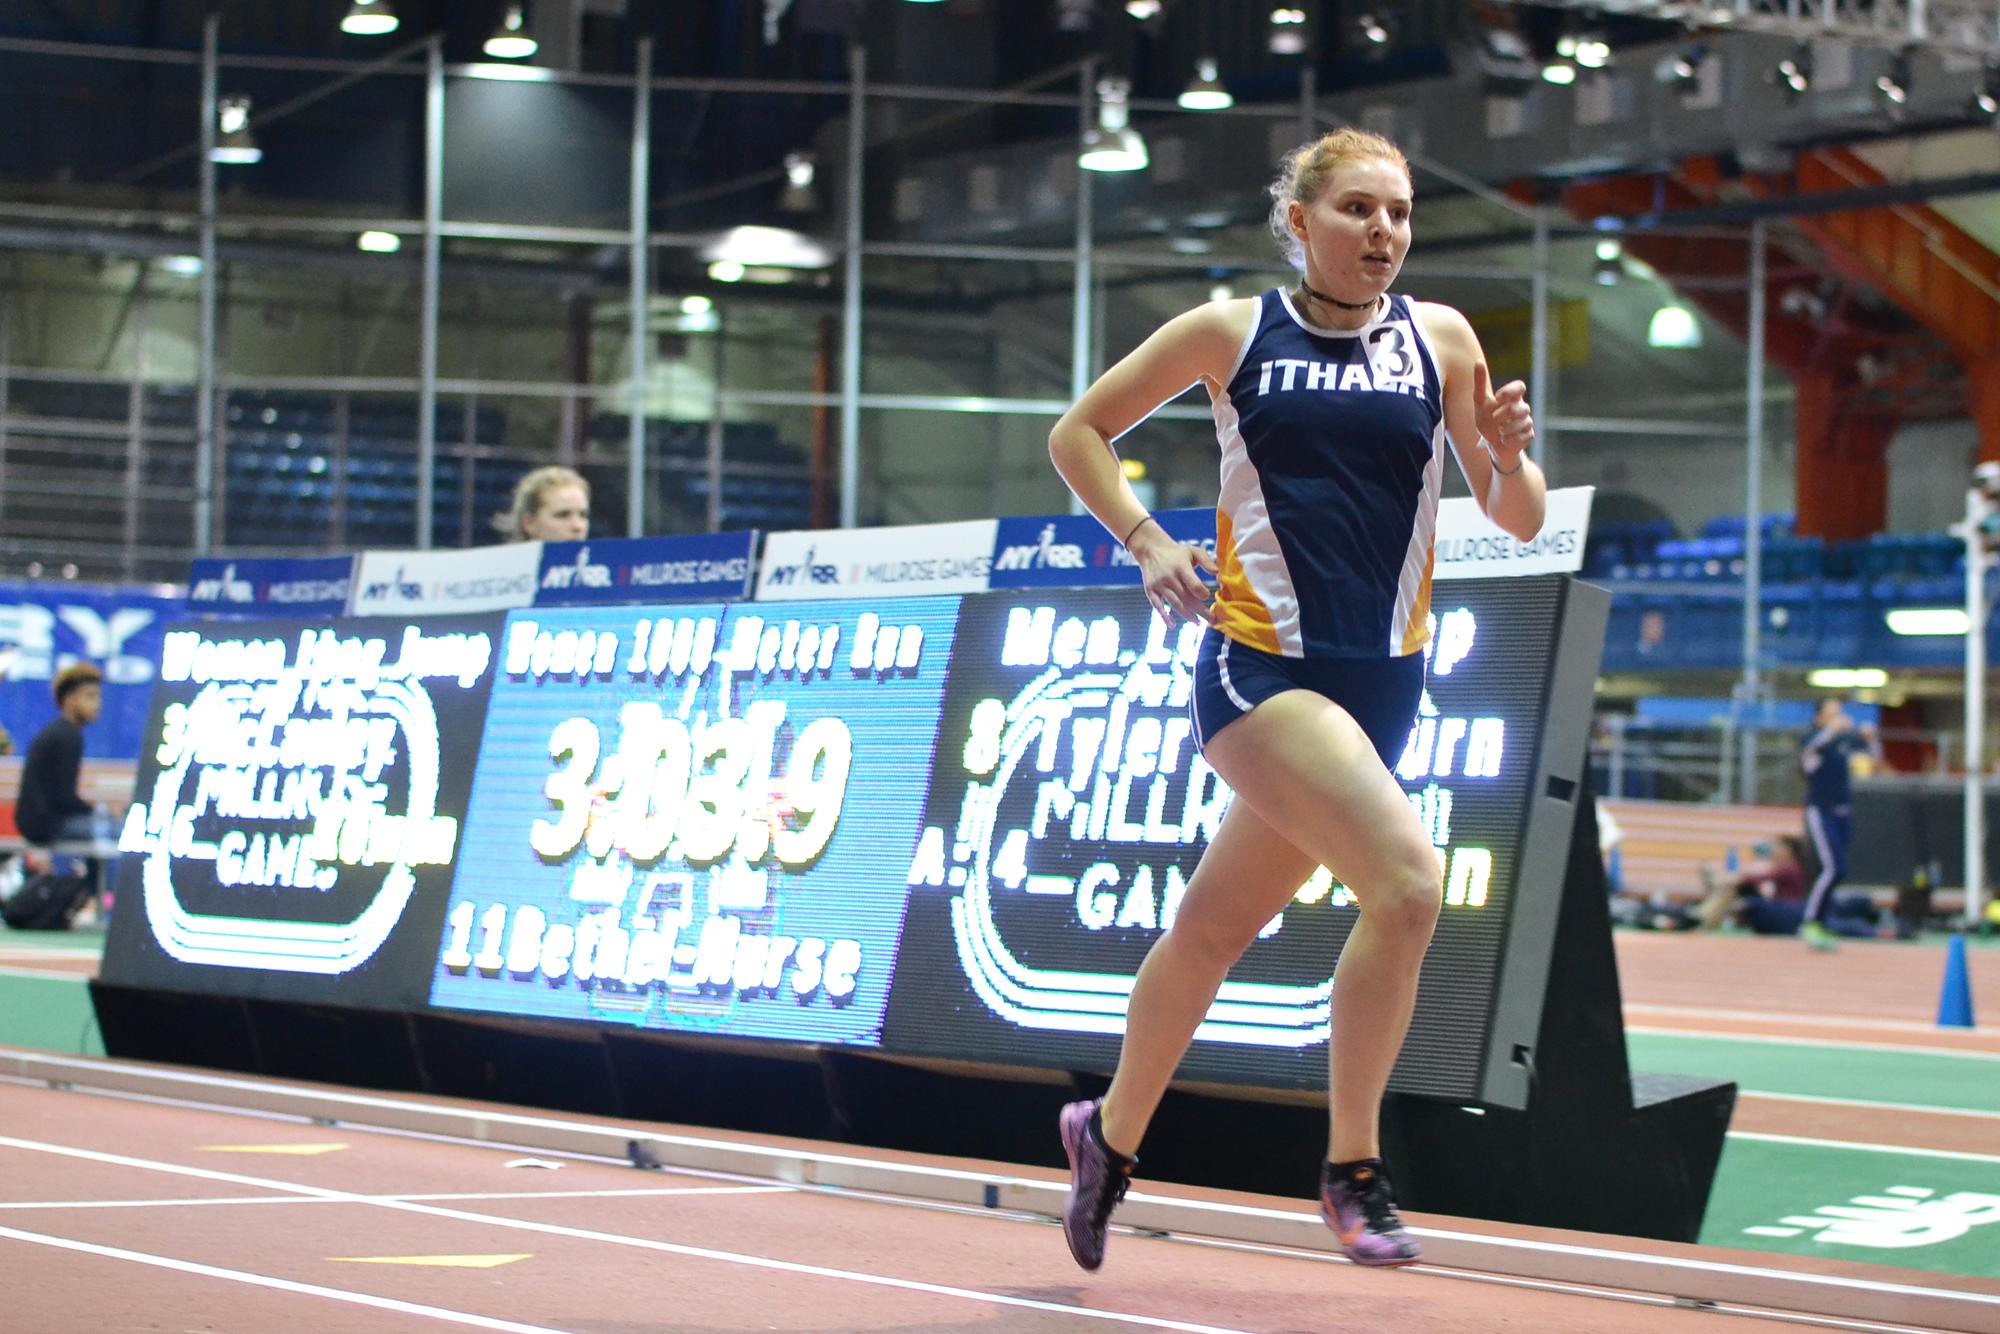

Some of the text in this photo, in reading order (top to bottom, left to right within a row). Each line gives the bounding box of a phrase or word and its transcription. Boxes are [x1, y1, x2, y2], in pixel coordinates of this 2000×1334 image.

[1368, 326, 1414, 377] 3
[1258, 358, 1426, 400] ITHA
[865, 559, 939, 584] MILLROSE
[940, 556, 993, 580] GAMES
[506, 620, 618, 677] Women
[849, 612, 924, 671] Run
[1033, 693, 1192, 792] Tyler
